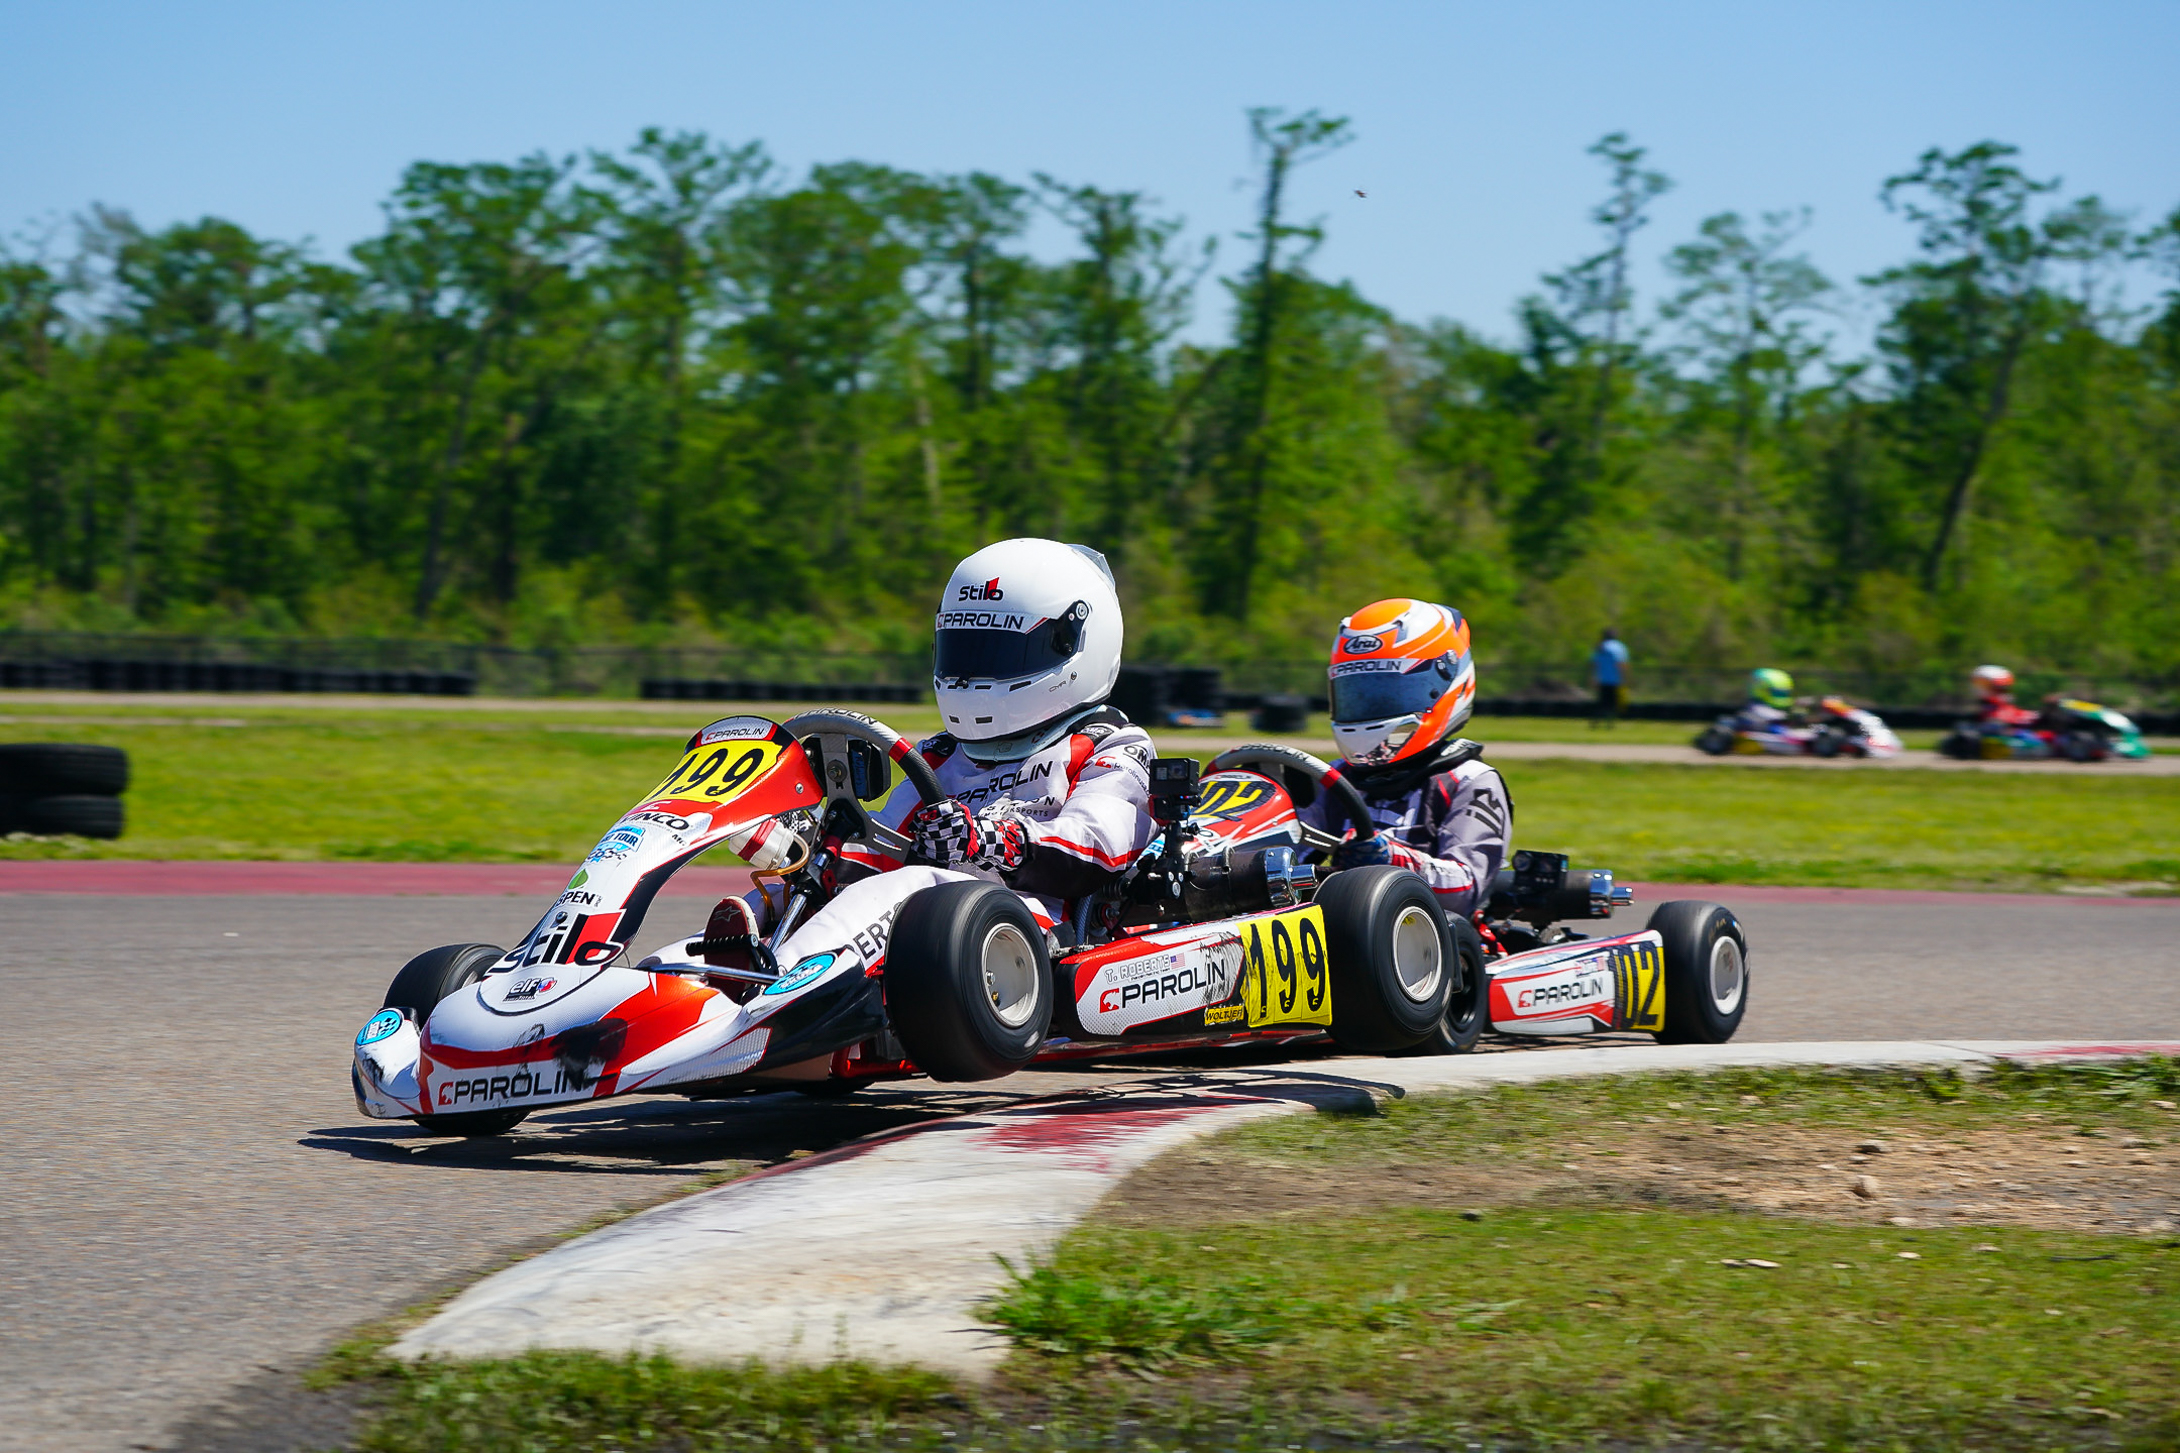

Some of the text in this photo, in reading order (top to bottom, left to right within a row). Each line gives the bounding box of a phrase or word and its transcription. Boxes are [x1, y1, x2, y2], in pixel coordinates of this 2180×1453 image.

[1349, 636, 1378, 650] Arai
[650, 748, 765, 800] 199
[554, 890, 596, 908] SPEN
[1120, 954, 1170, 979] ROBERTS
[1250, 917, 1327, 1019] 199
